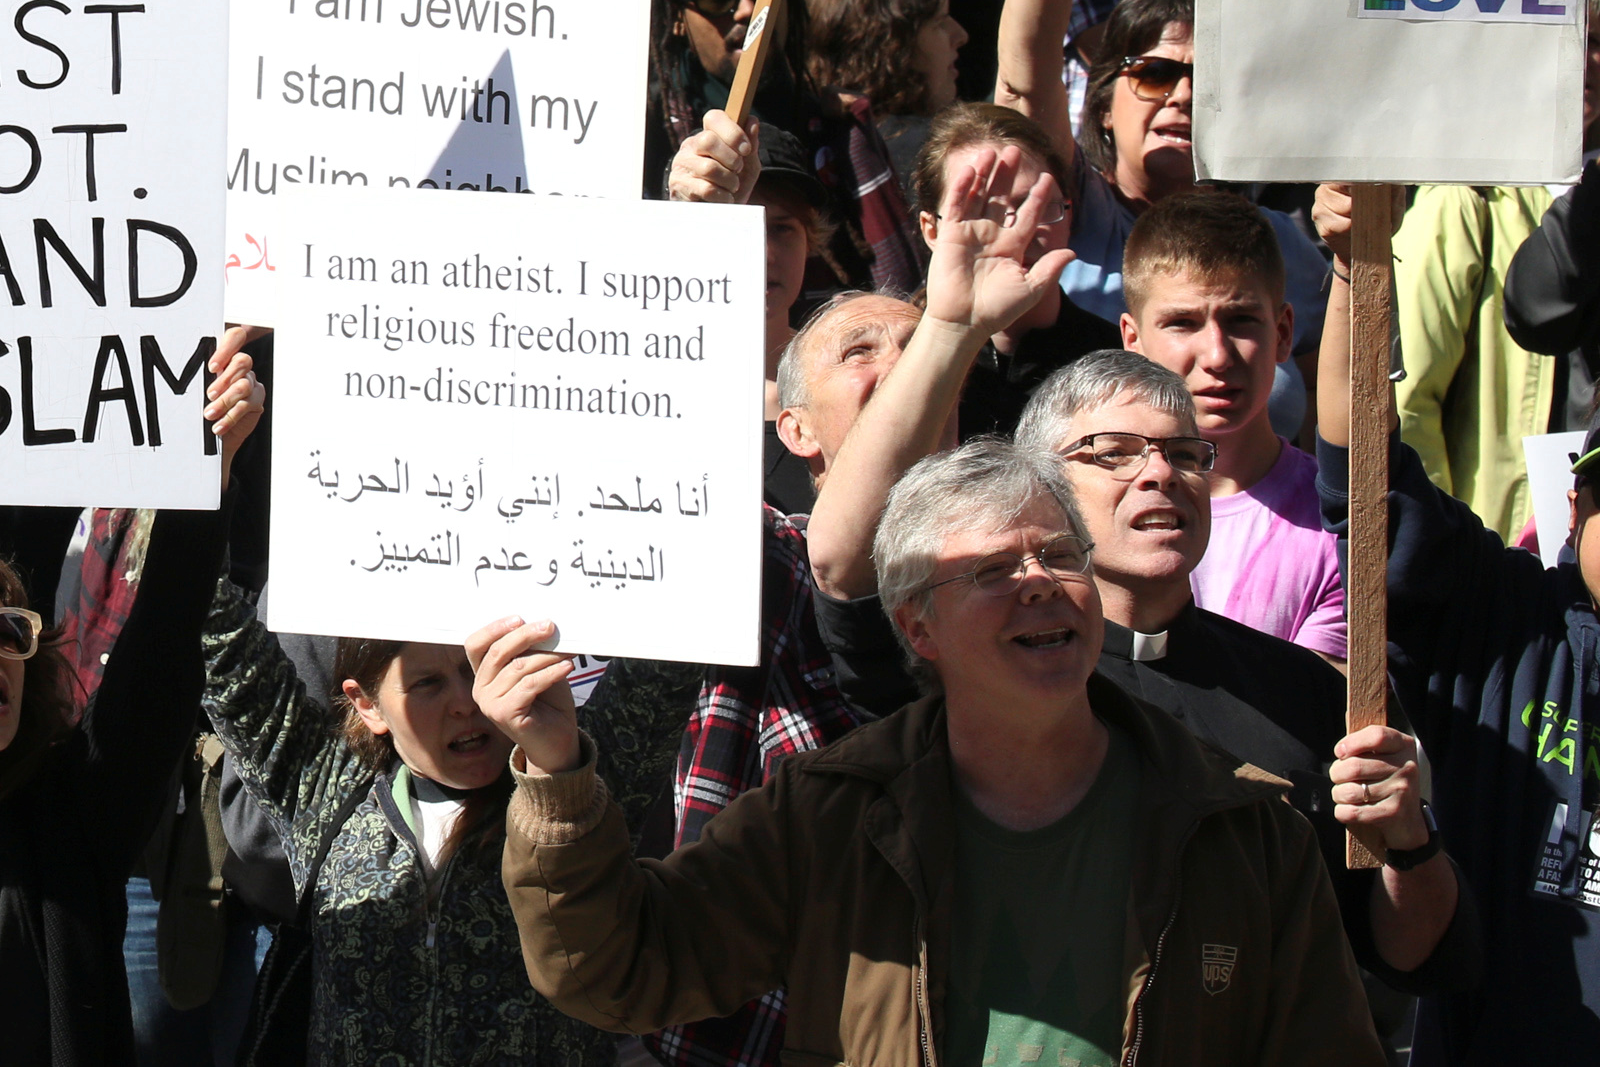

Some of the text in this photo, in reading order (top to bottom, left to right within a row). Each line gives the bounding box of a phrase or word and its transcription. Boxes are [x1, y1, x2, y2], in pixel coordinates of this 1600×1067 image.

[255, 55, 598, 144] I stand with my
[303, 243, 313, 279] I
[327, 253, 378, 284] am
[390, 256, 429, 287] an
[442, 249, 563, 296] atheist.
[577, 260, 588, 297] I
[602, 267, 731, 312] support
[325, 303, 705, 362] religious freedom and
[344, 368, 683, 421] non-discrimination.
[307, 448, 409, 504] الحرية
[425, 457, 484, 511] أؤيد
[497, 472, 561, 524] إنني
[677, 472, 709, 518] أنا
[570, 539, 664, 591] الدينية
